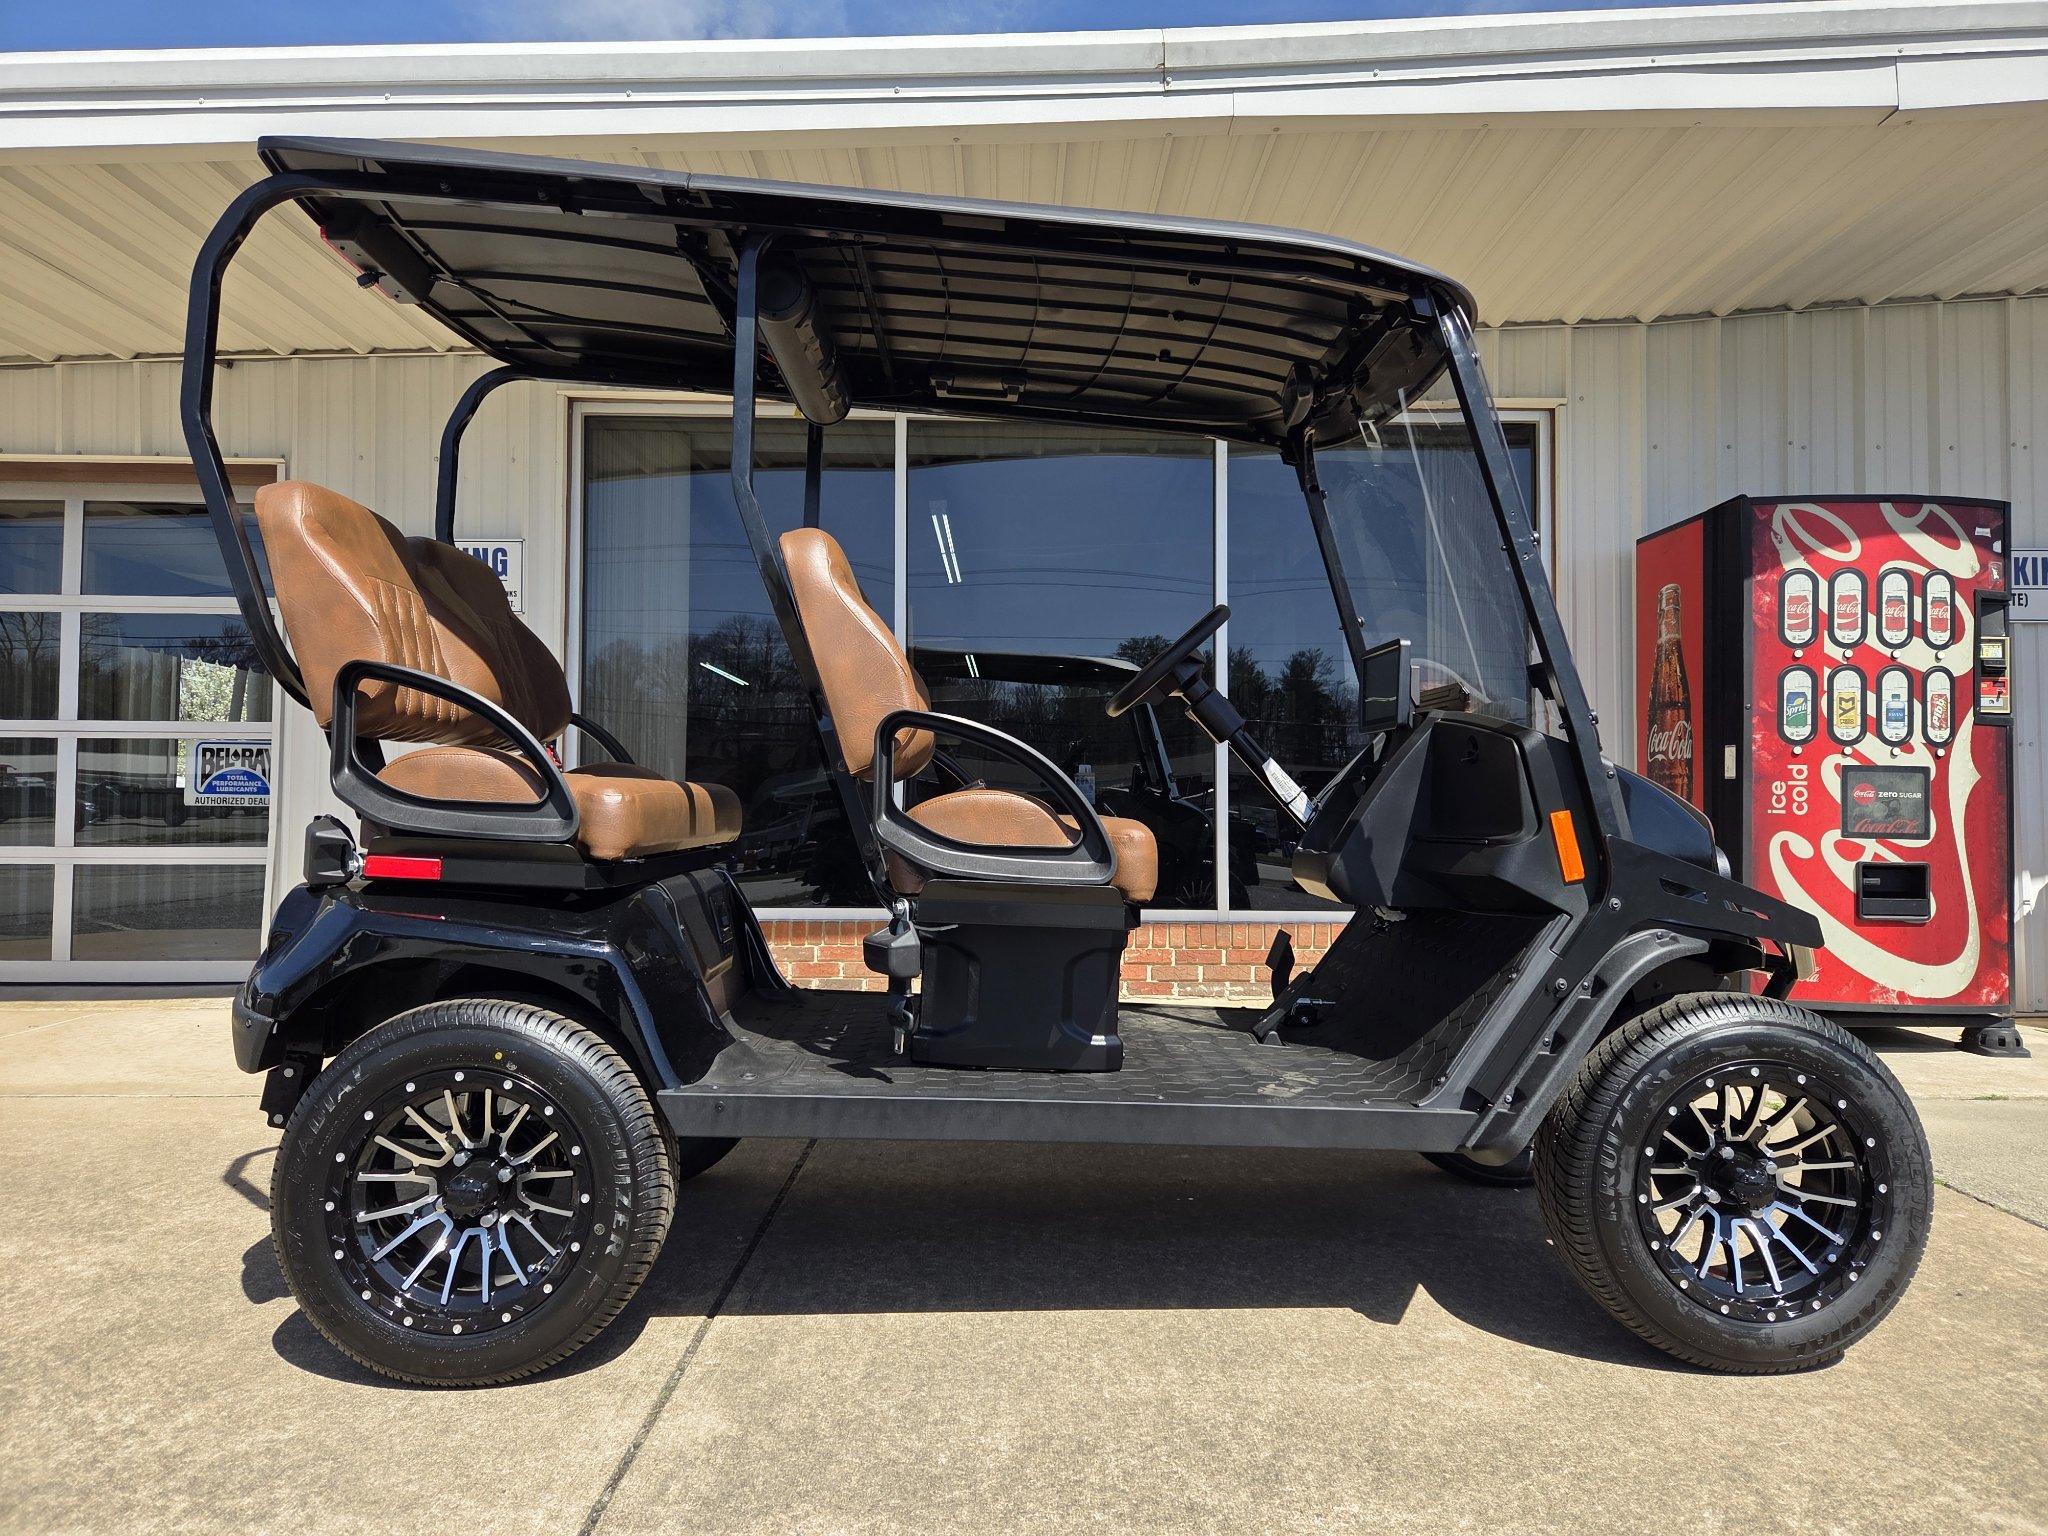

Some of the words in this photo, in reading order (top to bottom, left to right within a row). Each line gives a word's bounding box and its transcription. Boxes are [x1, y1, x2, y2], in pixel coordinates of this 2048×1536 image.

[194, 796, 246, 806] AUTHORIZED
[247, 797, 271, 806] DEAL
[1767, 780, 1787, 815] ice
[1787, 764, 1809, 816] cold
[1877, 790, 1898, 798] zero
